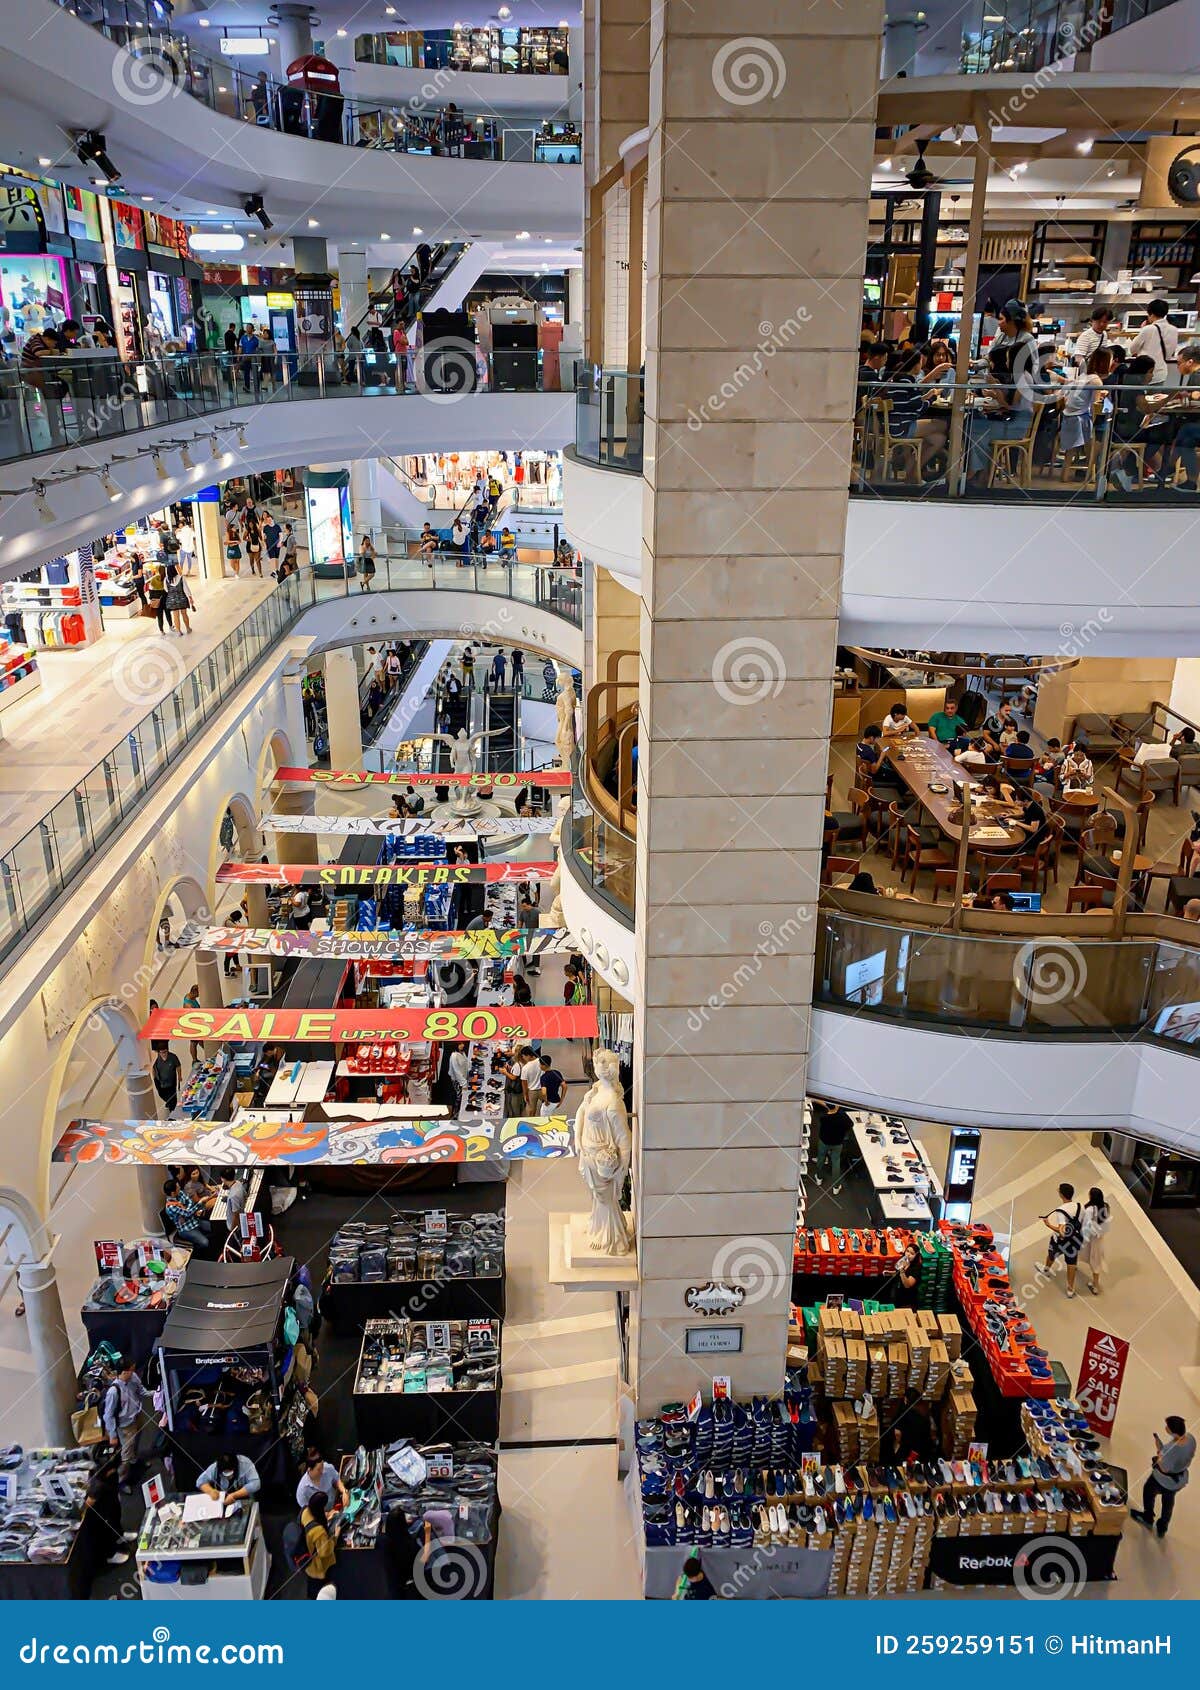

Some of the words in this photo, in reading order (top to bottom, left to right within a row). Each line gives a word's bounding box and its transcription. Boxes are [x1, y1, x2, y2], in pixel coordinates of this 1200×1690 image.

[310, 770, 411, 785] SALE
[319, 866, 472, 884] SNEAKERS
[171, 1010, 338, 1041] SALE
[1088, 1358, 1119, 1380] 999
[1087, 1377, 1120, 1399] SALE
